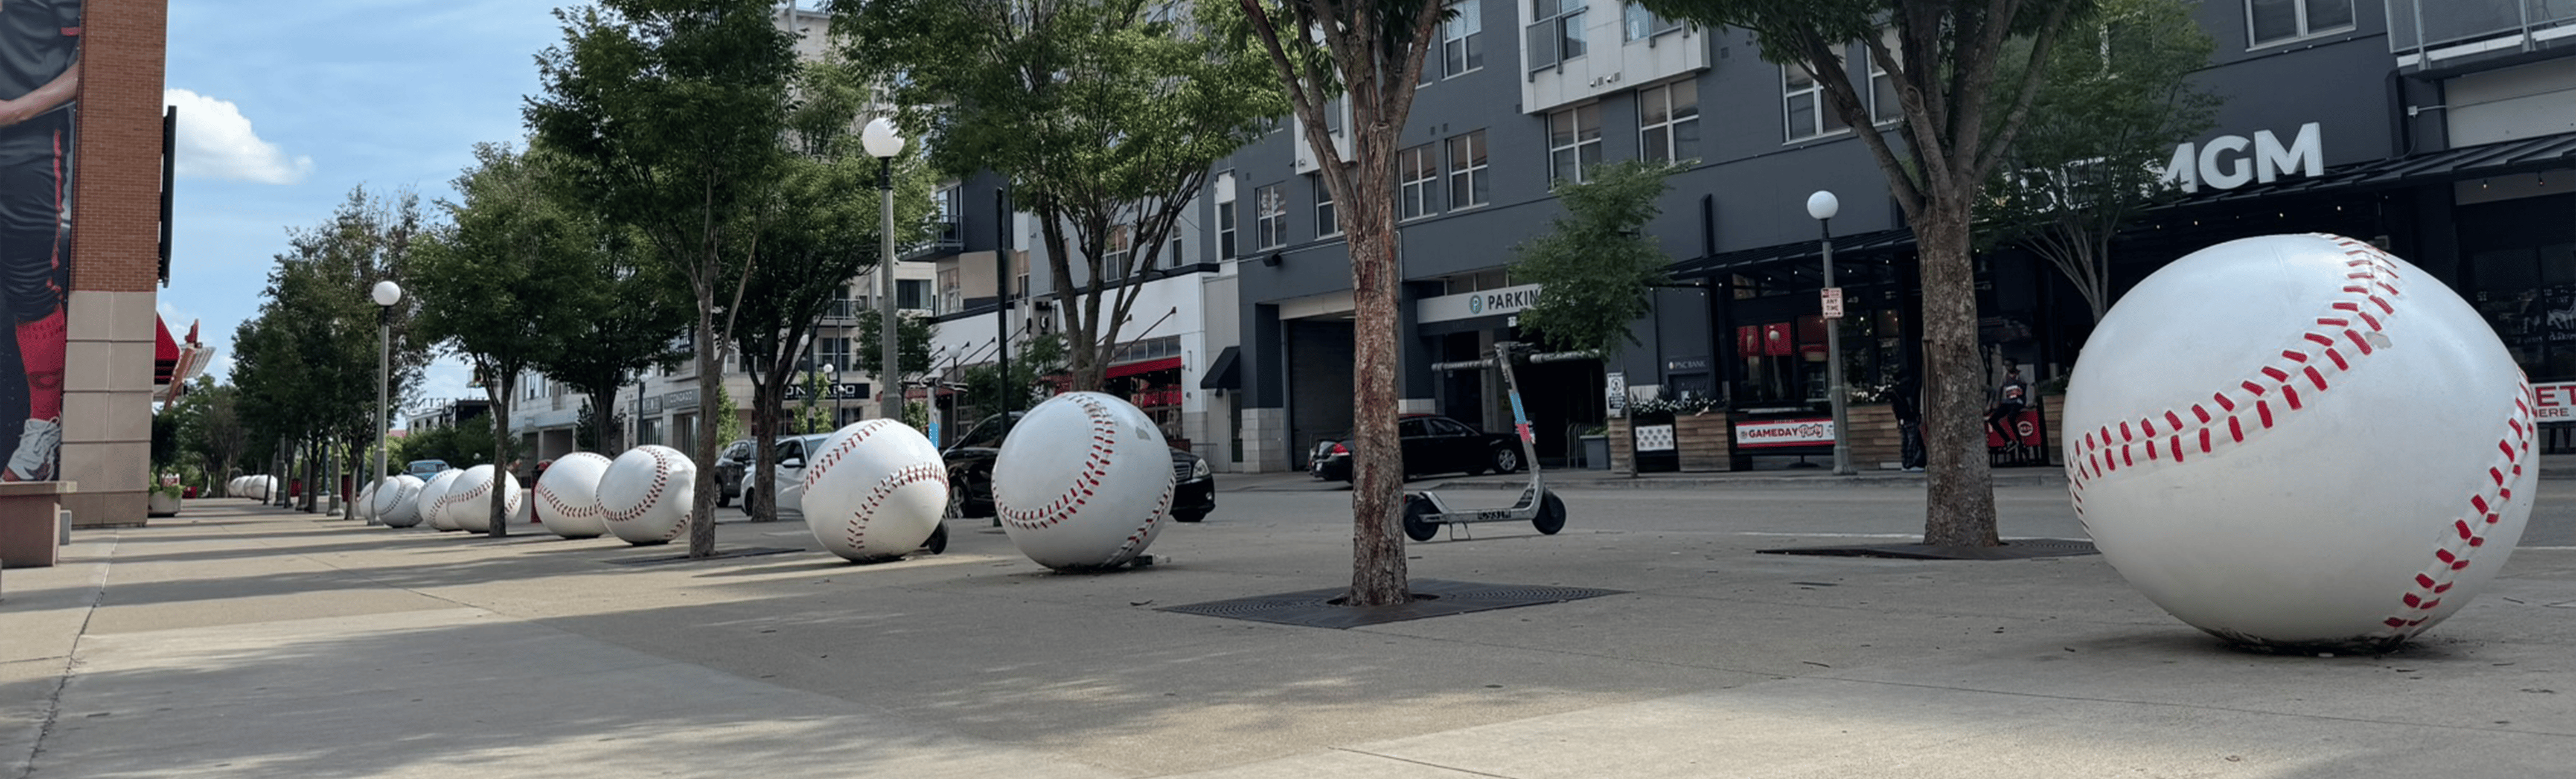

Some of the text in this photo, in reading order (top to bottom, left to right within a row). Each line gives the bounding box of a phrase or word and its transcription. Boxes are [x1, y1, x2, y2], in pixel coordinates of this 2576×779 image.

[1488, 289, 1538, 310] PARKIN
[2535, 386, 2576, 406] ET
[1749, 427, 1798, 438] GAMEDAY
